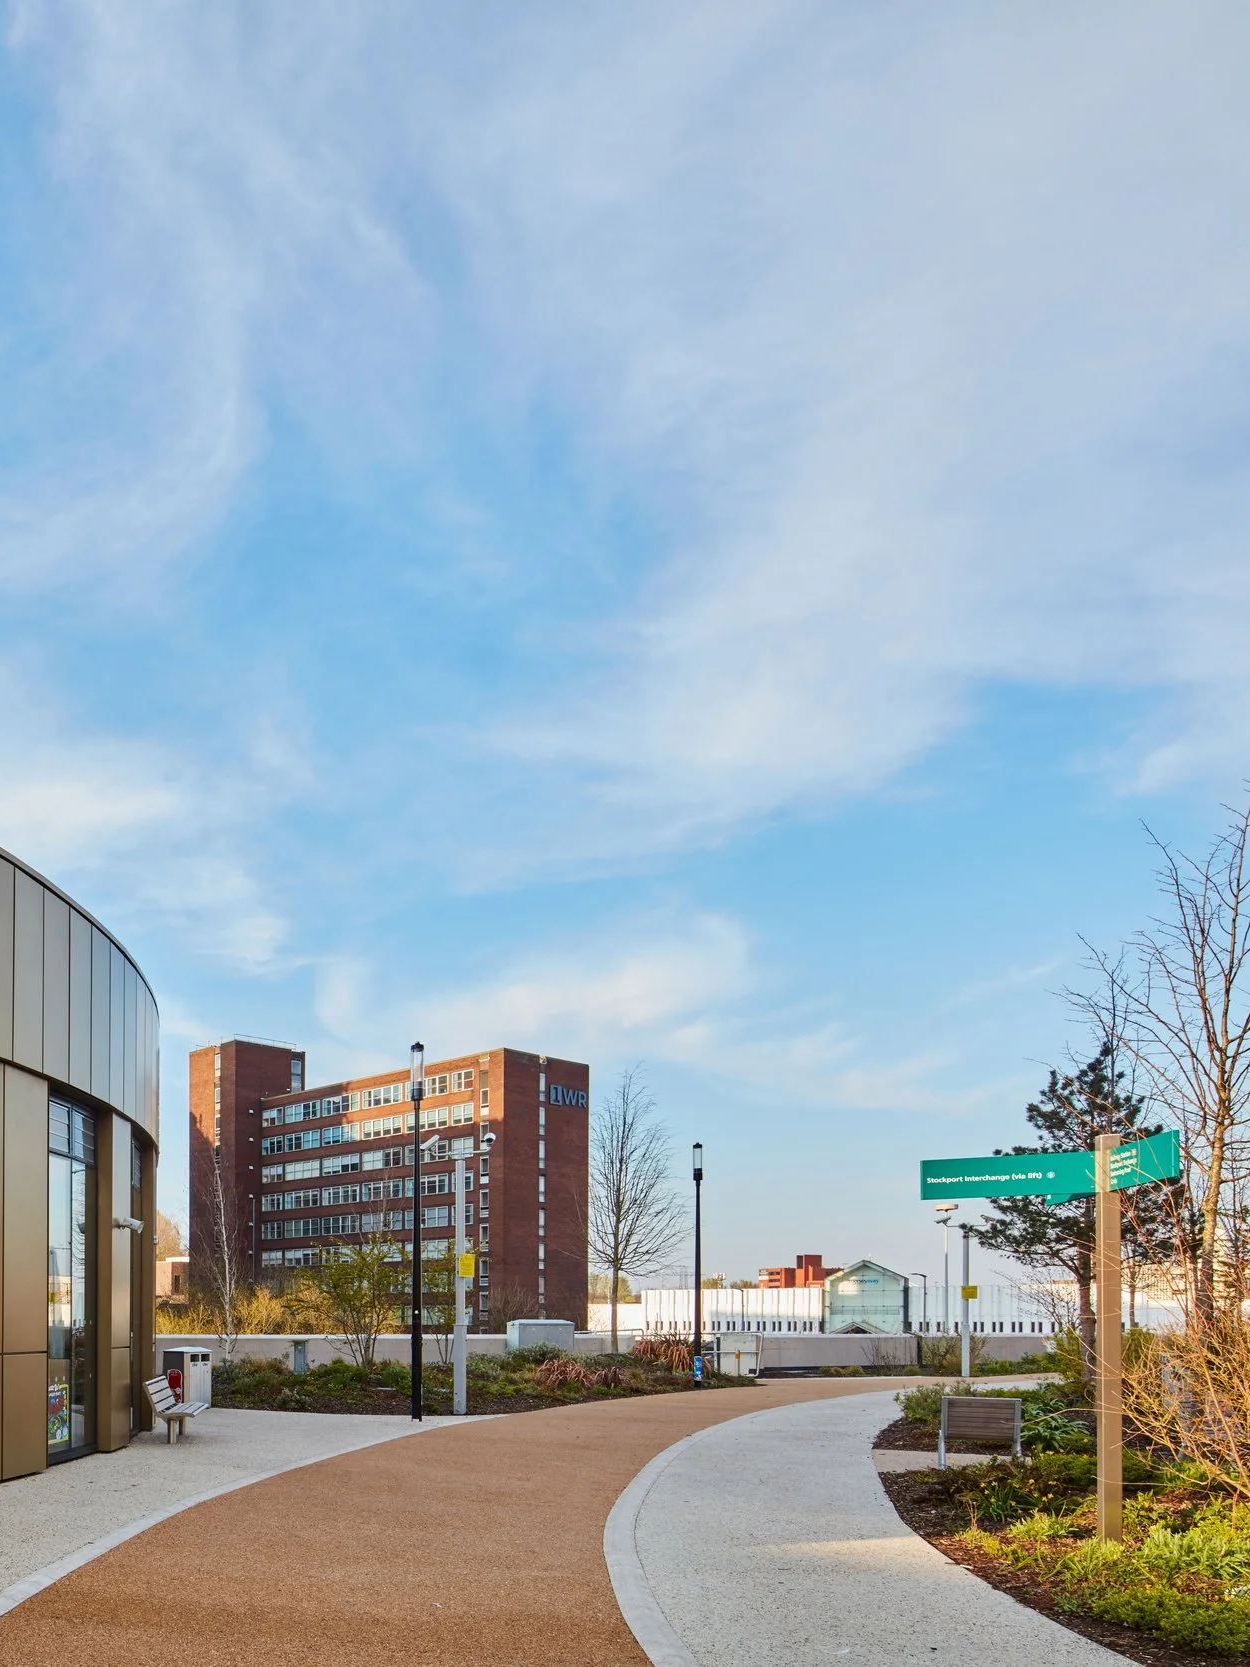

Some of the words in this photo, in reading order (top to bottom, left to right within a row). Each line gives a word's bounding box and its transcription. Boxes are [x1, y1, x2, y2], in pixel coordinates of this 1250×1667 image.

[549, 1084, 587, 1108] 1WR
[926, 1176, 963, 1184] Stockport
[964, 1174, 1010, 1182] Interchange
[1011, 1173, 1026, 1181] (via
[1027, 1171, 1043, 1179] lift)
